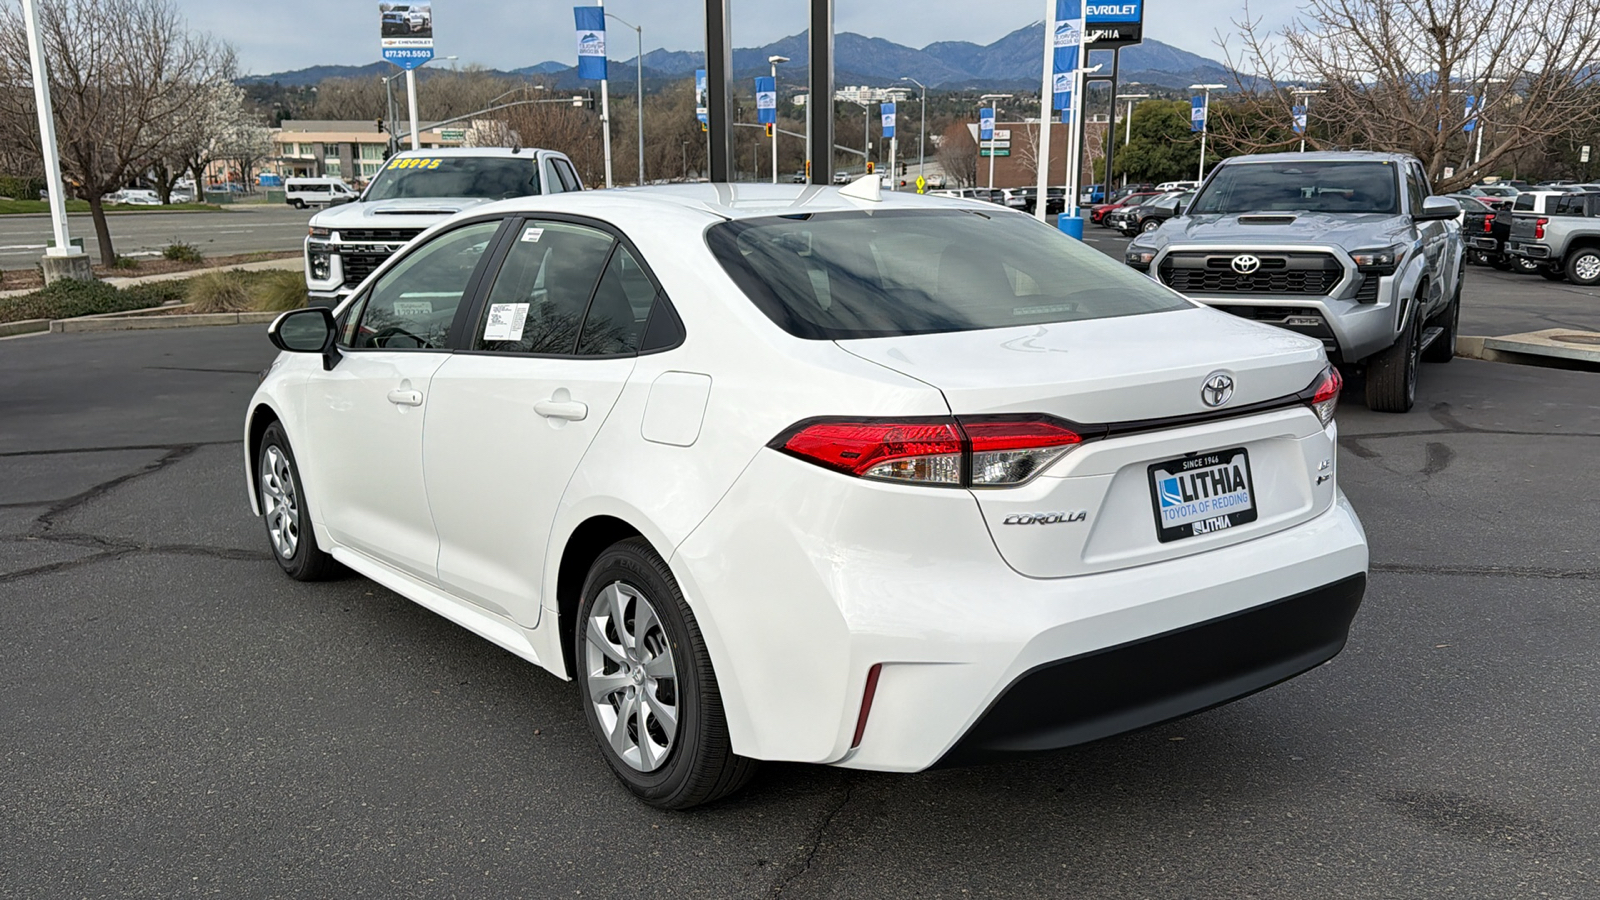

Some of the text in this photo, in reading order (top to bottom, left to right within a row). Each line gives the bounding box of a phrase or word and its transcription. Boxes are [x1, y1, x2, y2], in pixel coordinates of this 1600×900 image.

[385, 50, 431, 58] 877.293.5503
[387, 158, 443, 170] 38995
[1182, 455, 1219, 470] SINCE 1946
[1179, 465, 1246, 503] LITHIA
[1163, 492, 1248, 520] TOYOTA OF REDDING
[1003, 510, 1087, 525] COROLLA
[1201, 515, 1232, 534] LITHIA
